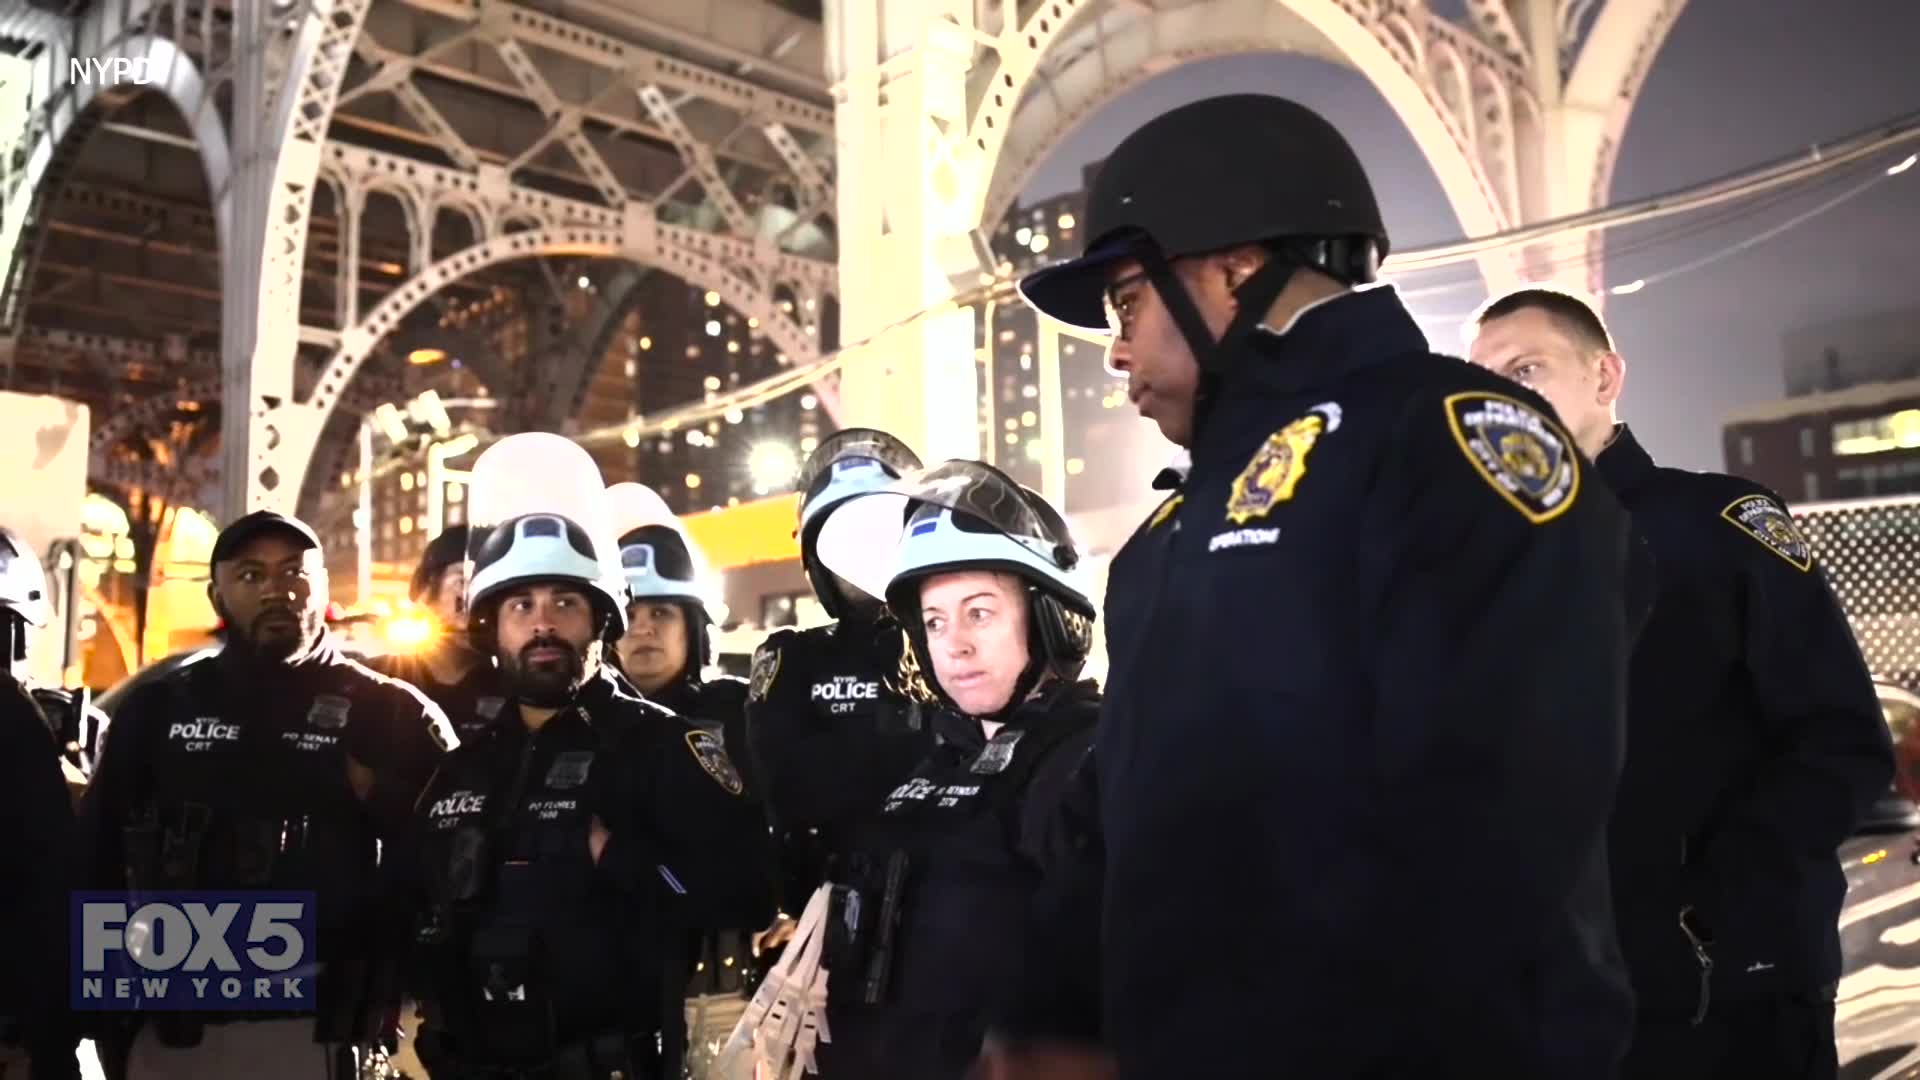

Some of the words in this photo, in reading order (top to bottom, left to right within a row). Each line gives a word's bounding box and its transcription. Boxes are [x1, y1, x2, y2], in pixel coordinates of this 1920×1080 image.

[811, 682, 879, 701] POLICE
[830, 702, 856, 714] CRT
[168, 722, 241, 740] POLICE
[184, 741, 213, 752] CRT
[429, 795, 486, 819] POLICE
